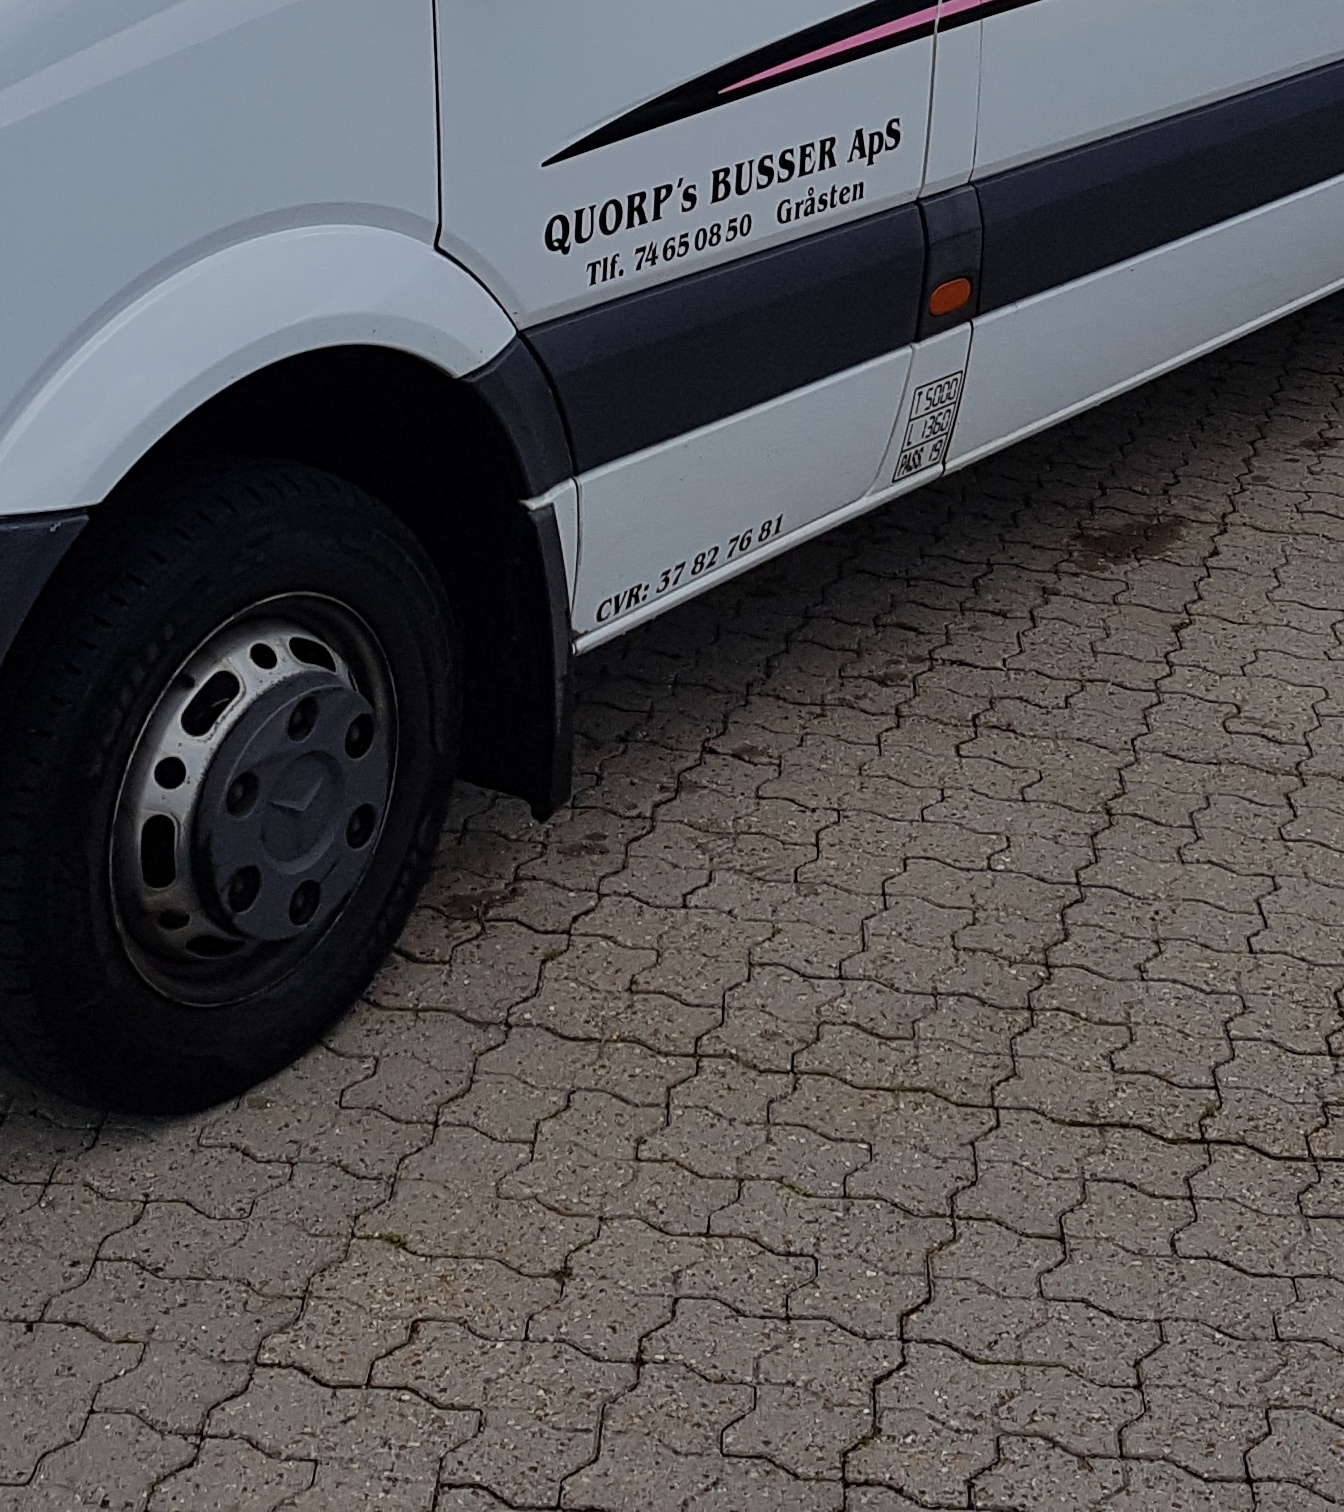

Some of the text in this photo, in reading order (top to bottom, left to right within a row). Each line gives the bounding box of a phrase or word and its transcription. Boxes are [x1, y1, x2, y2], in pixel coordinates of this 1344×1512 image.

[544, 118, 902, 256] QUORP's BUSSER ApS
[586, 254, 624, 286] Tlf.
[777, 180, 866, 225] Gråsten
[924, 377, 959, 412] 5000
[595, 513, 784, 623] CVR: 37 82 76 81
